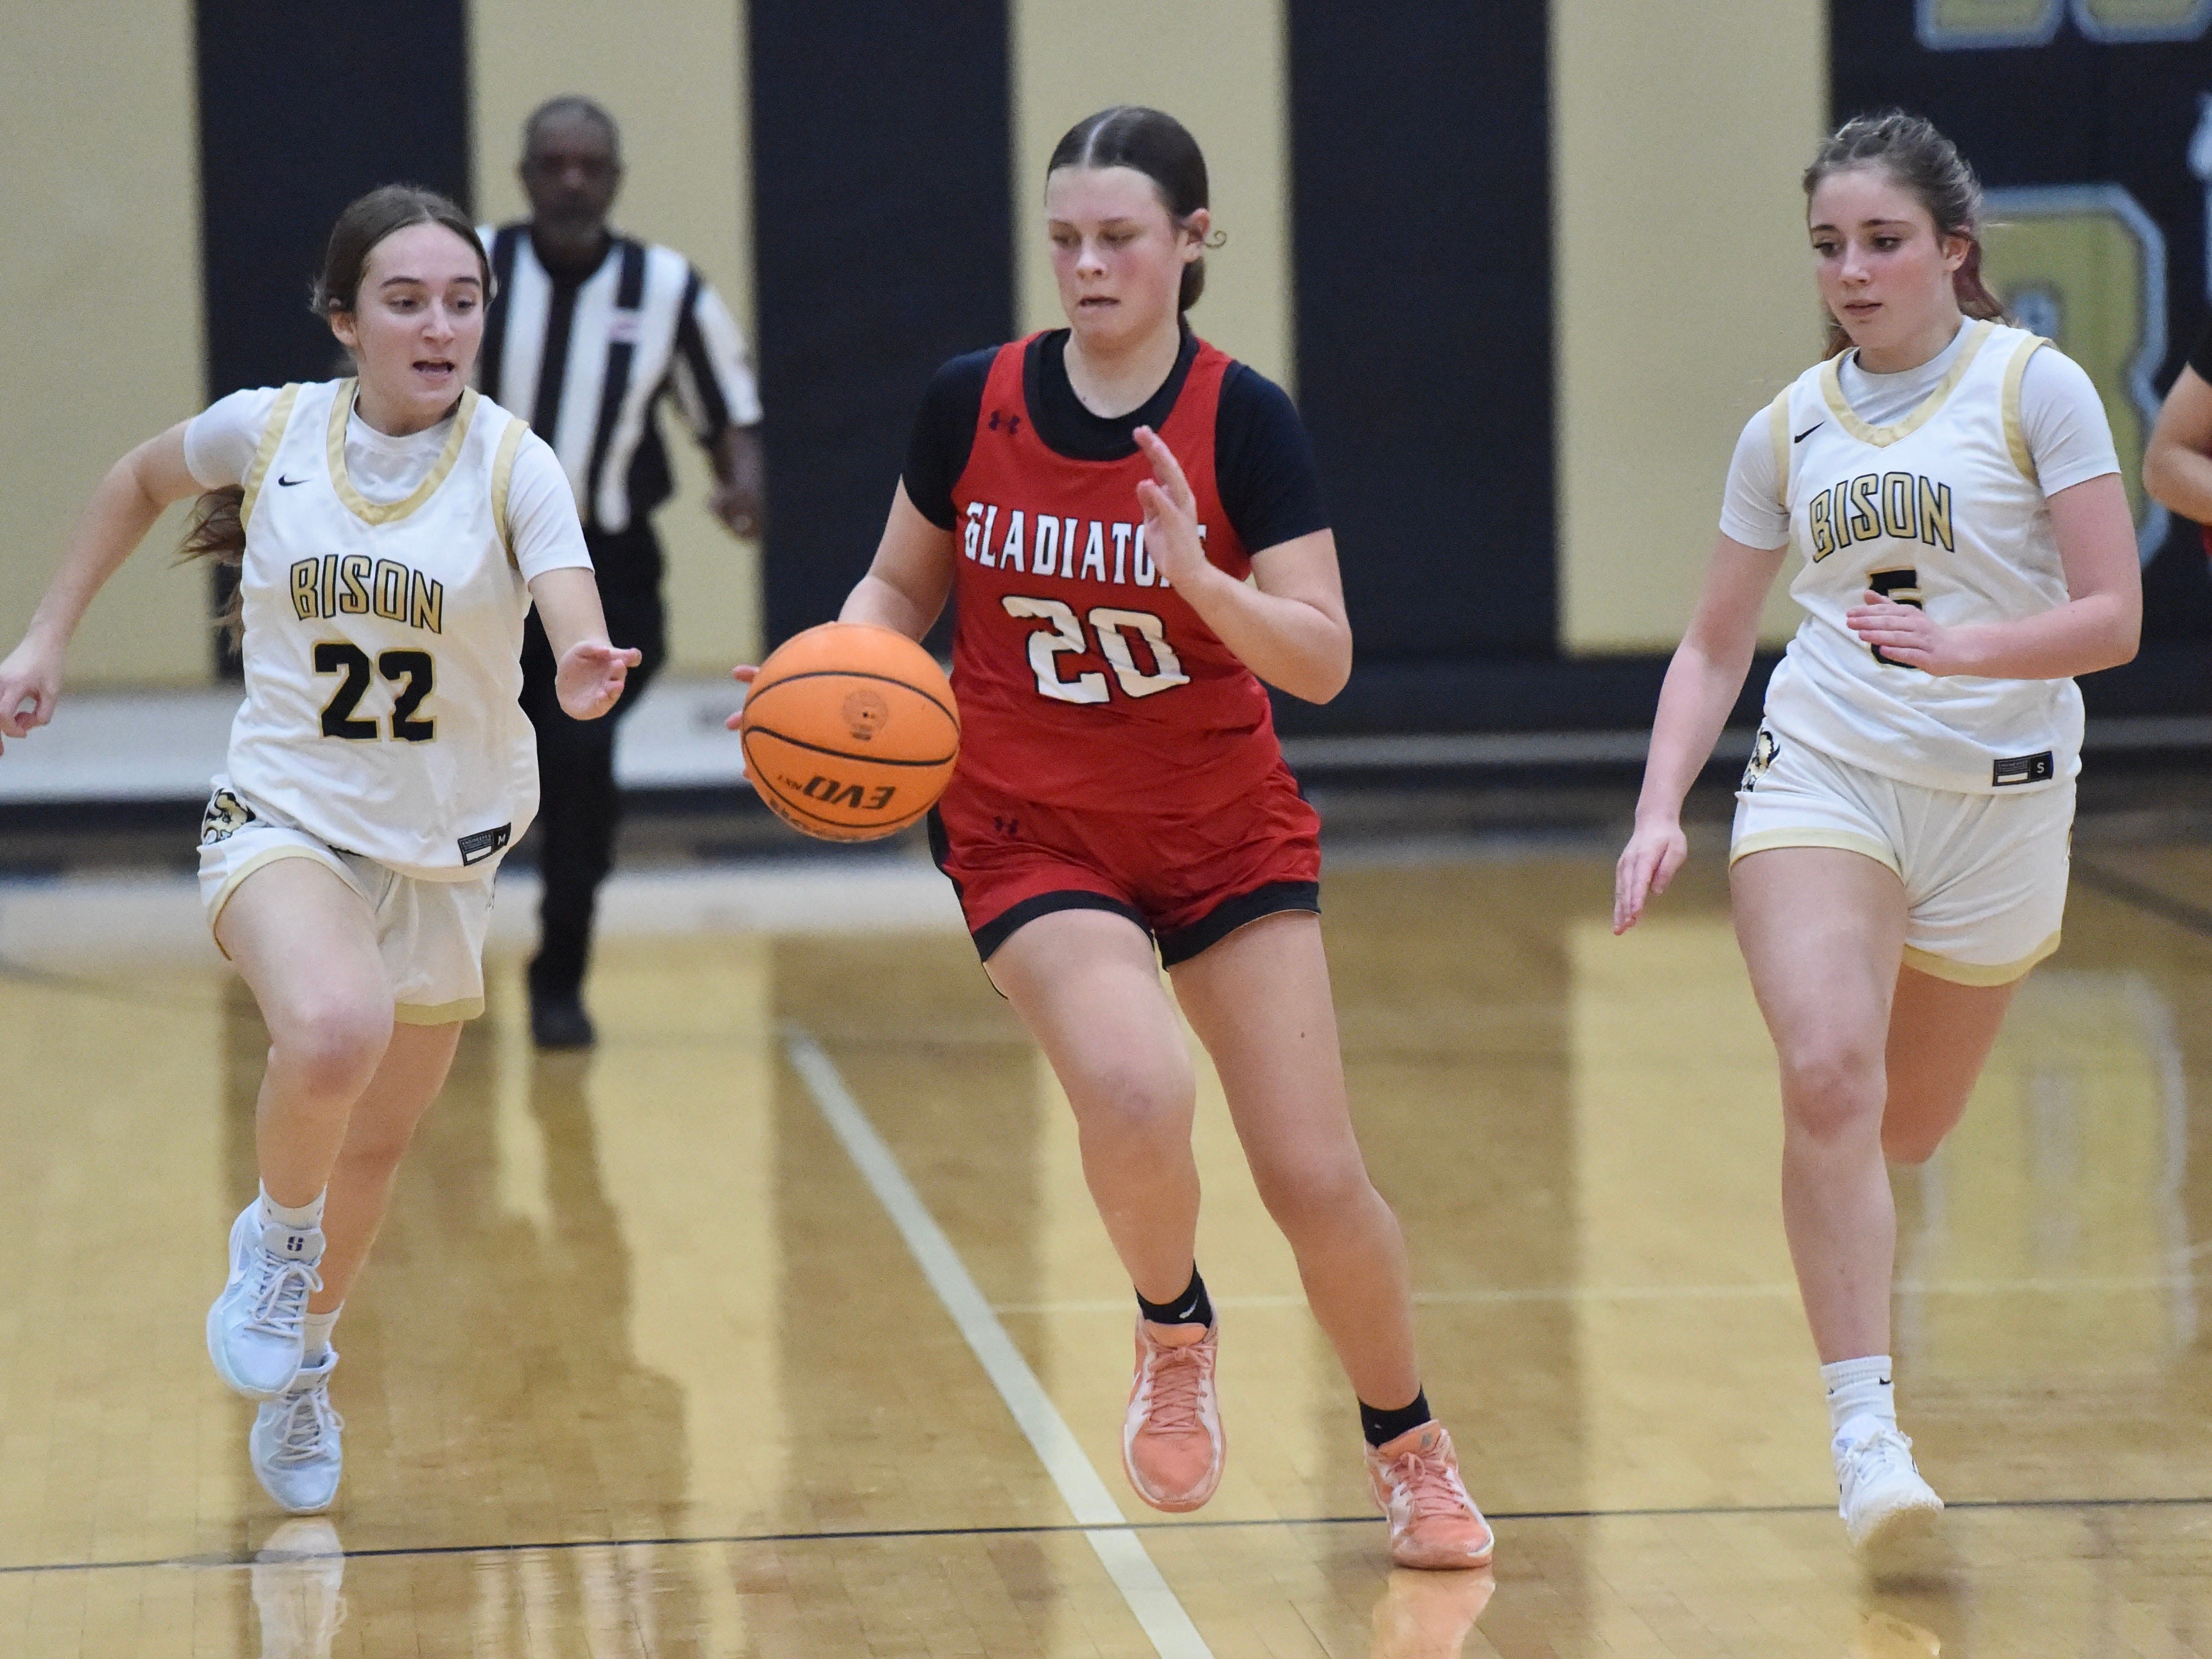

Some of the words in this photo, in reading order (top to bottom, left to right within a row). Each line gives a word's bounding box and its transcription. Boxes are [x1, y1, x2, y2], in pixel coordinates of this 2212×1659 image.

[964, 501, 1207, 588] GLADIATO
[1810, 471, 1955, 563] BISON
[290, 553, 443, 635] BISON
[1001, 595, 1191, 704] 20
[313, 641, 436, 743] 22
[803, 775, 896, 810] EVO
[2037, 762, 2045, 774] S
[498, 833, 506, 845] M
